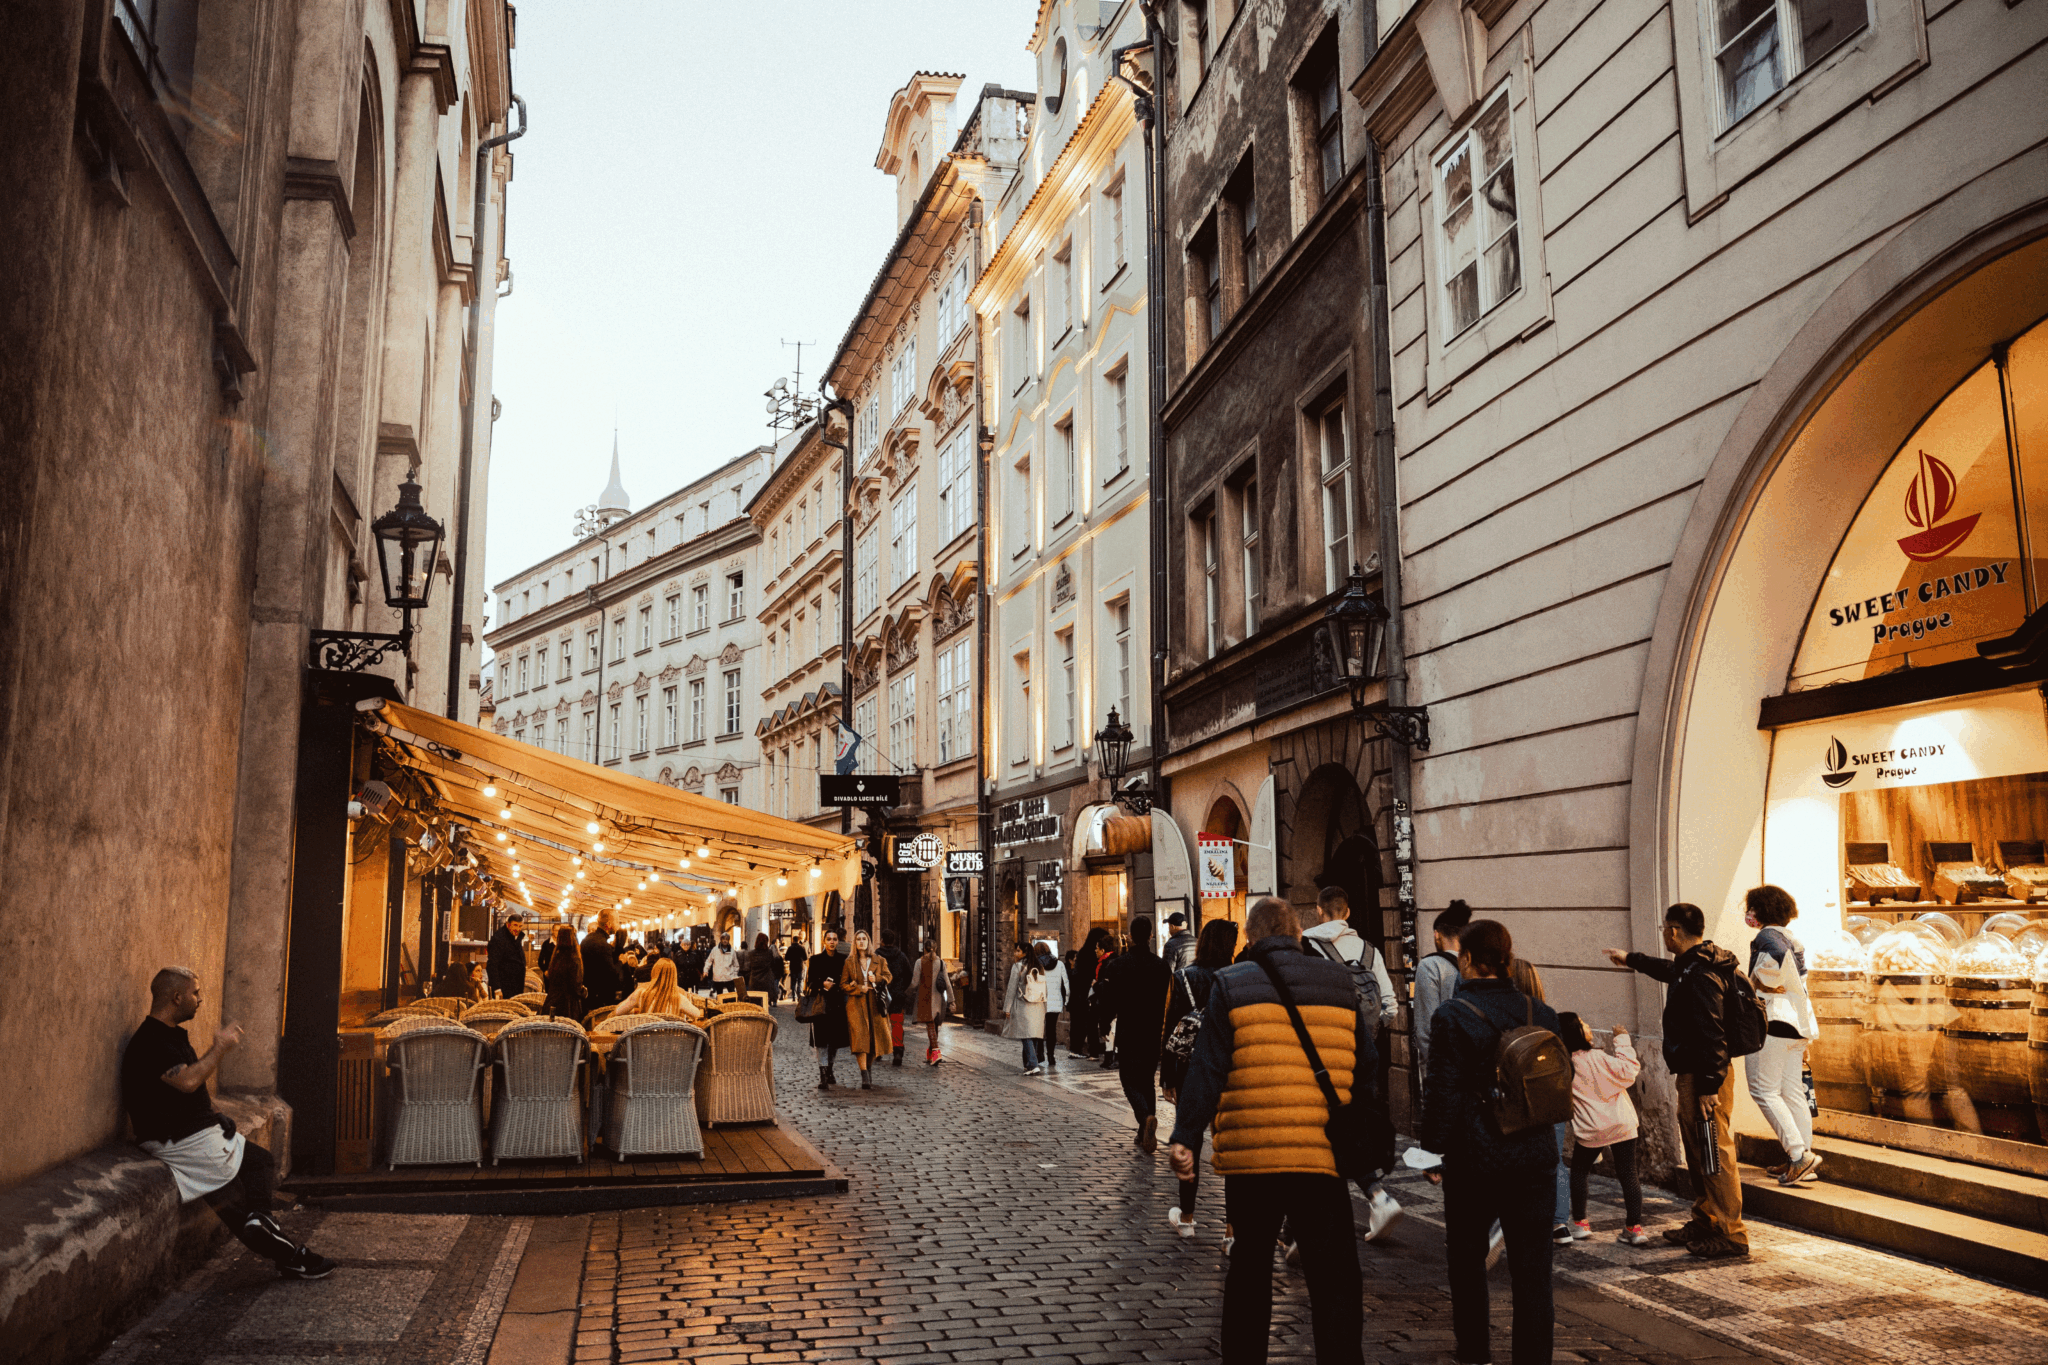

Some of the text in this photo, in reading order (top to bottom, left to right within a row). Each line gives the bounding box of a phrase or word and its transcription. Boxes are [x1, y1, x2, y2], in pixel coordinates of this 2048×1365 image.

[1829, 561, 2011, 627] SWEET CANDY
[1872, 612, 1953, 644] Prague
[1851, 744, 1946, 766] SWEET CANDY
[1876, 766, 1917, 779] Prague
[950, 852, 983, 861] MUSIC
[949, 861, 984, 871] CLUB
